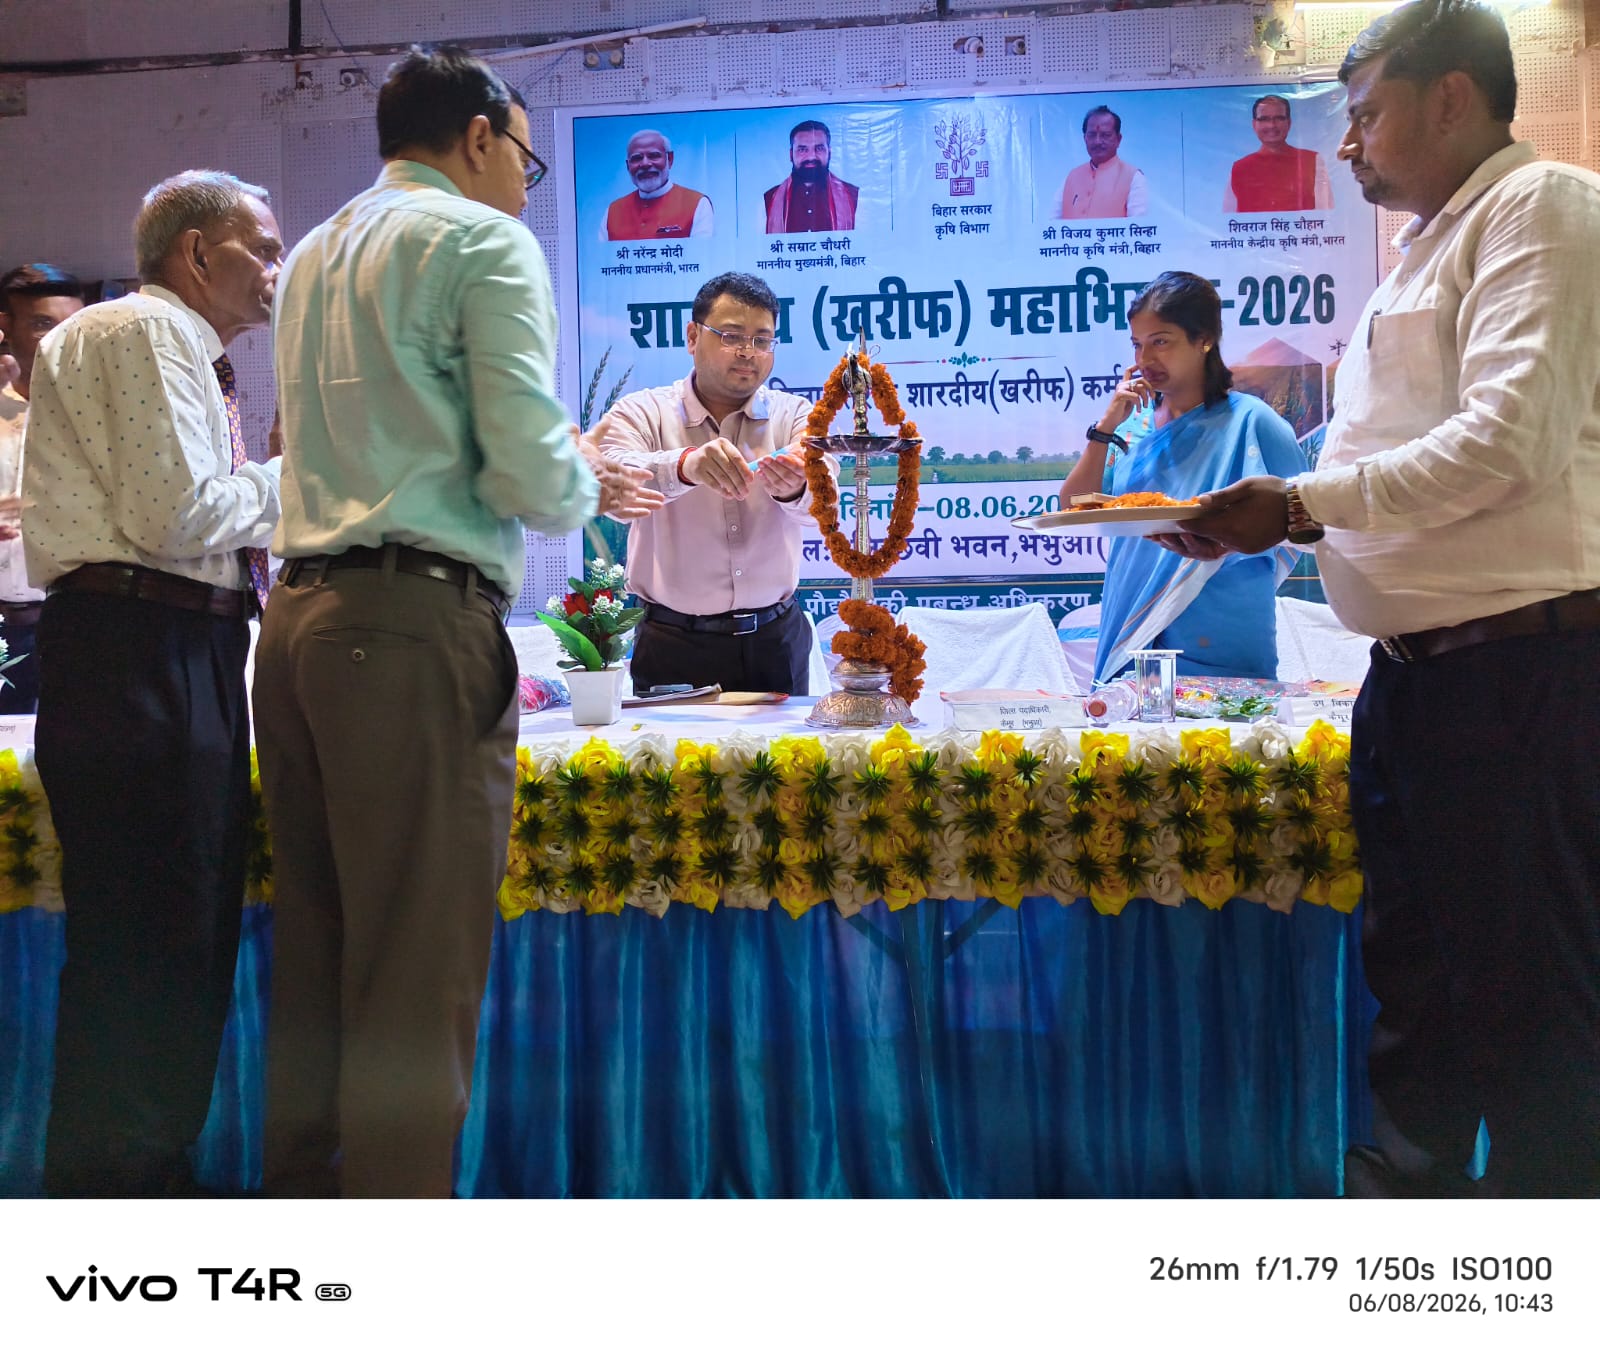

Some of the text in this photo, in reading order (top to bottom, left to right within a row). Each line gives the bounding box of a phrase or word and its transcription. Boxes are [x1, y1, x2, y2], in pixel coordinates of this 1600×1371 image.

[932, 203, 992, 217] बिहार सरकार
[934, 221, 990, 240] कृषि विभाग
[1042, 223, 1157, 242] श्री विजय कुमार सिन्हा
[1228, 216, 1325, 233] शिवराज सिंह चौहान
[616, 246, 630, 259] श्री
[660, 244, 683, 258] मोदी
[770, 237, 851, 253] श्री सम्राट चौधरी
[1039, 243, 1079, 257] माननीय
[1083, 242, 1105, 259] कृषि
[1210, 237, 1244, 249] माननीय
[1247, 235, 1275, 248] केन्द्रीय
[1279, 235, 1298, 252] कृषि
[601, 264, 632, 276] माननीय
[678, 263, 700, 273] भारत
[756, 257, 791, 270] माननीय
[841, 254, 866, 267] बिहार
[812, 276, 971, 350] (खरीफ)
[1331, 699, 1356, 707] विका
